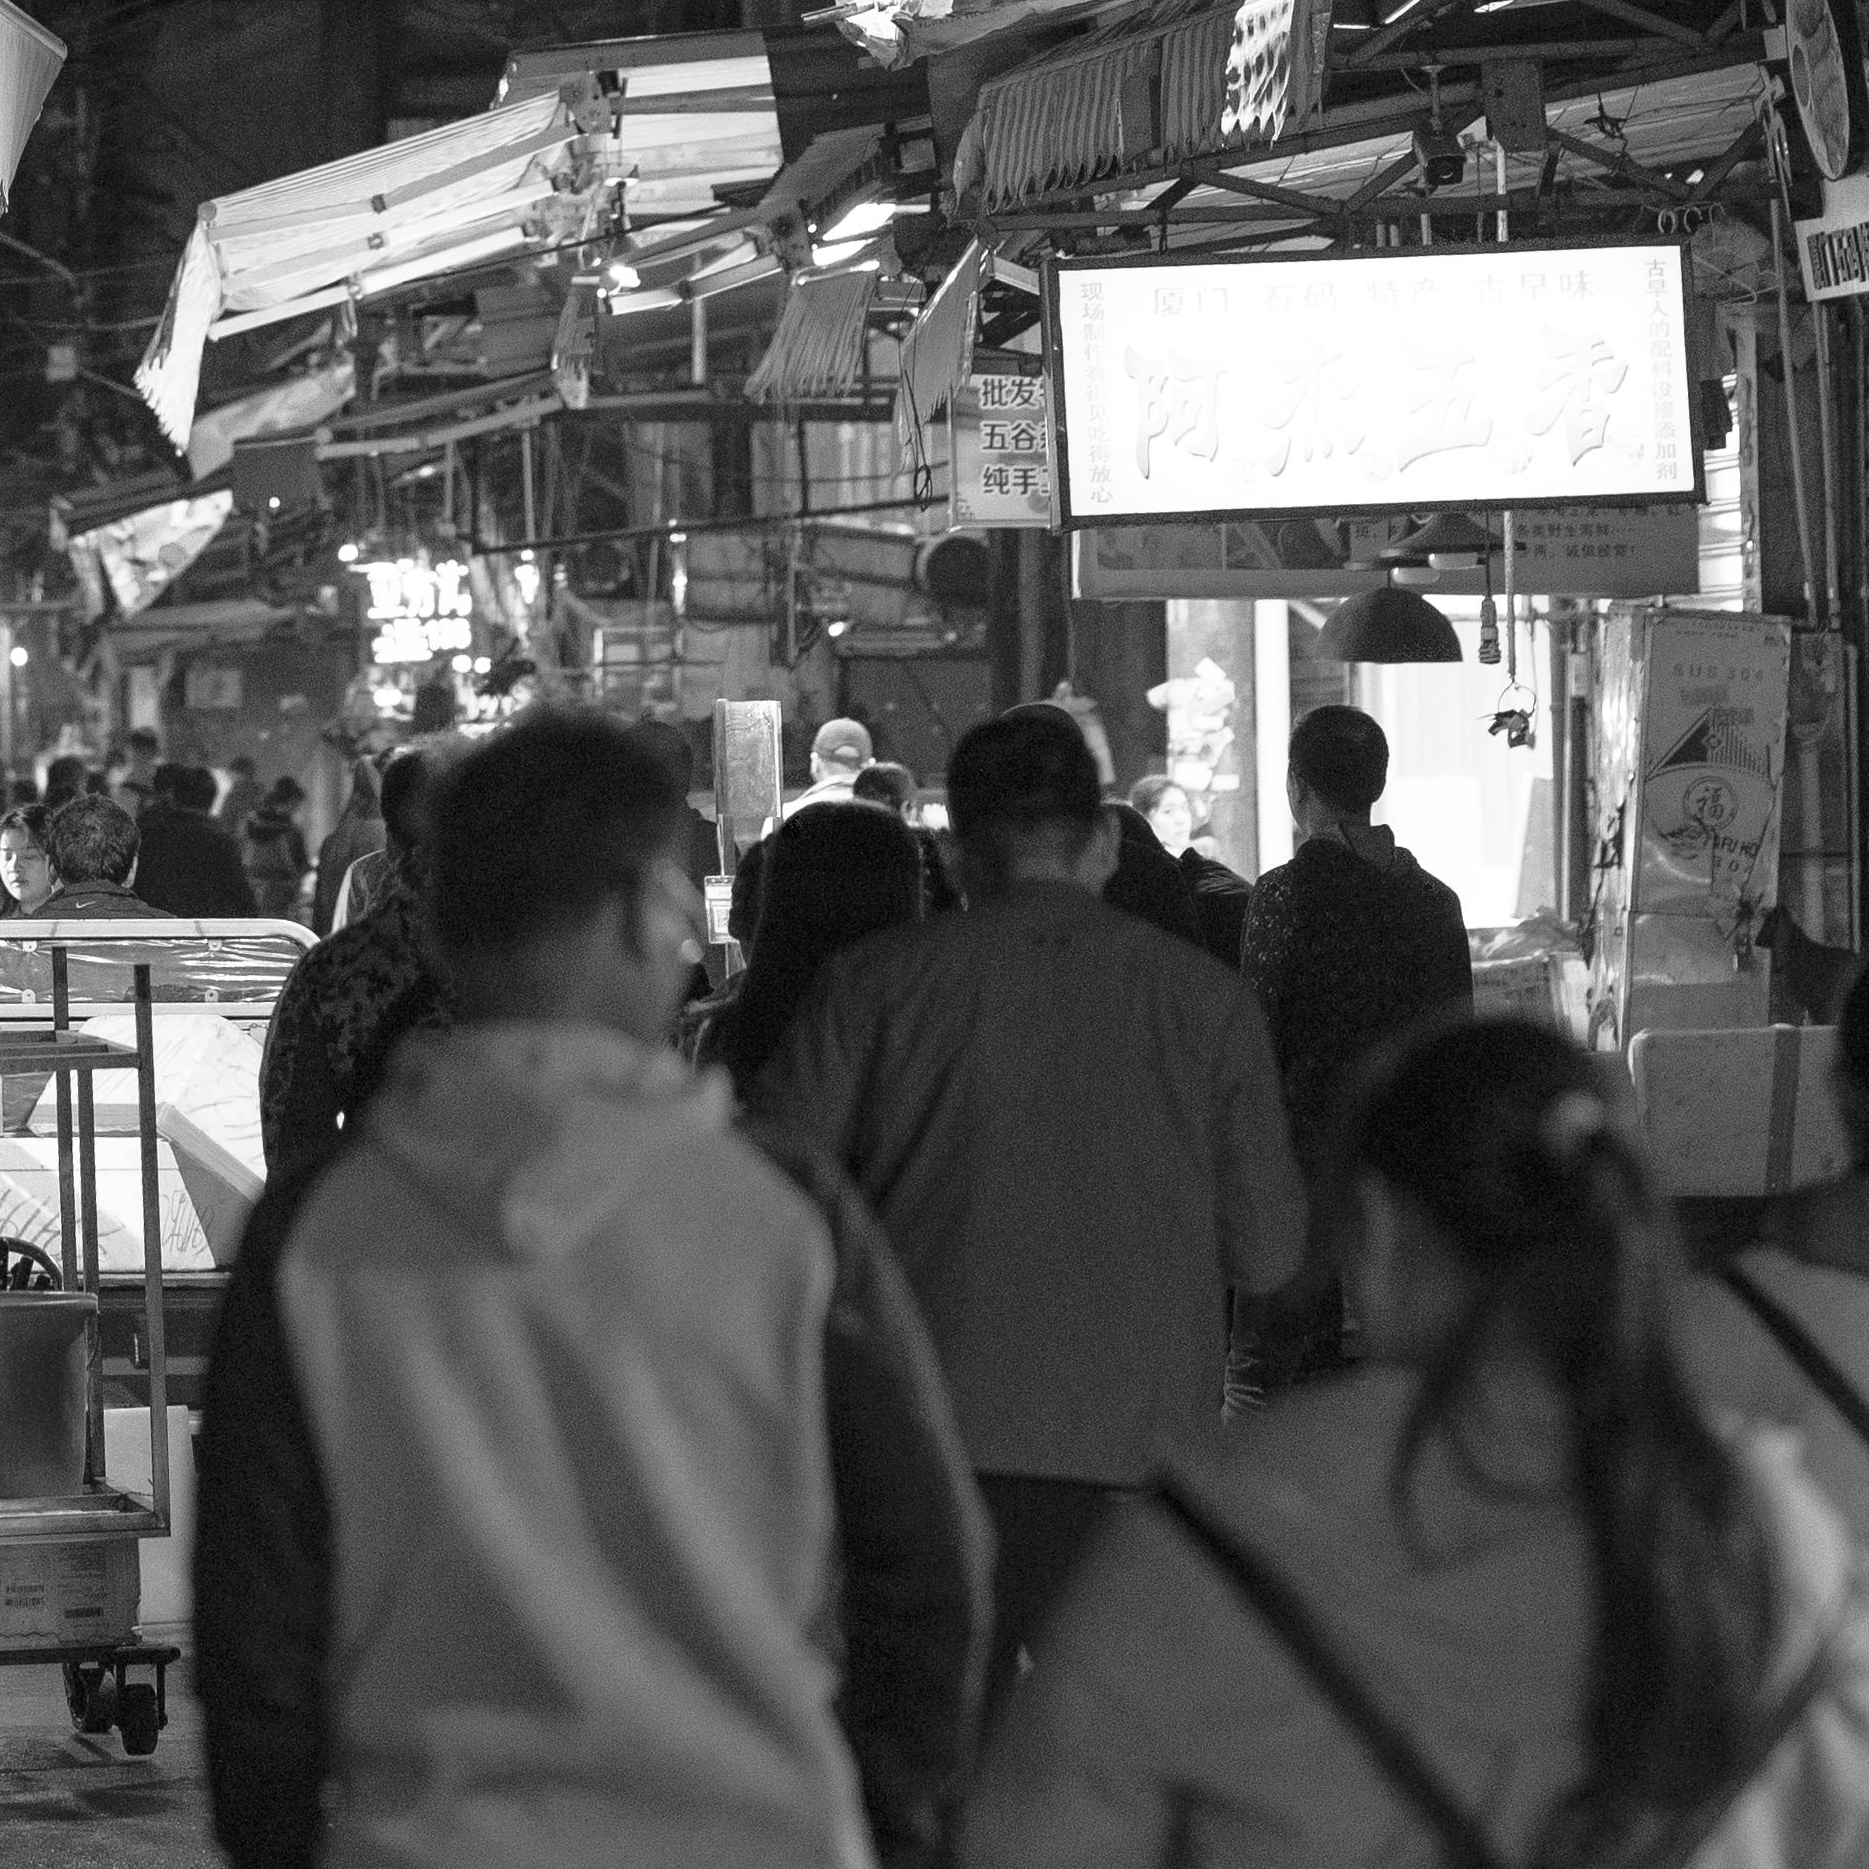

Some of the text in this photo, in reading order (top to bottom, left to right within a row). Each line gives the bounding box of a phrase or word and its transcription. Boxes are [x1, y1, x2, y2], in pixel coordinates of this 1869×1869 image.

[1153, 269, 1597, 319] 厦门 石码 特产 古早味
[982, 378, 1045, 407] 批发
[1123, 323, 1632, 480] 阿杰五香
[982, 422, 1046, 451] 五谷
